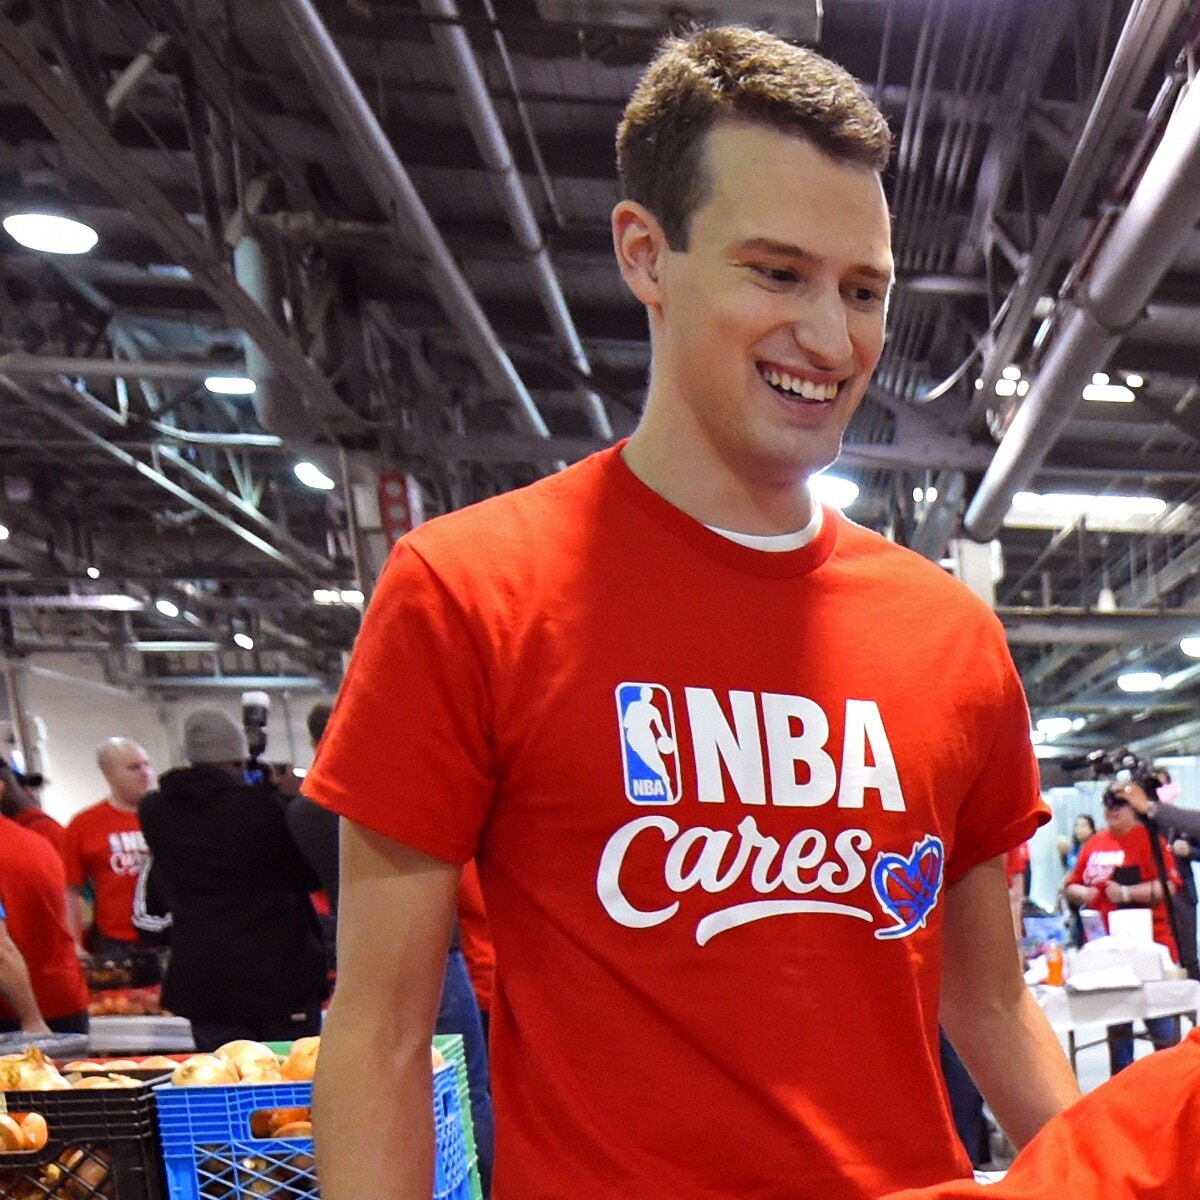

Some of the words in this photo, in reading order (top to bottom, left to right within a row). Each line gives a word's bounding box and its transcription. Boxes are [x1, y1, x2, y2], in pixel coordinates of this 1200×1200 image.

[633, 778, 665, 797] NBA
[685, 686, 906, 812] NBA
[597, 815, 873, 930] Cares
